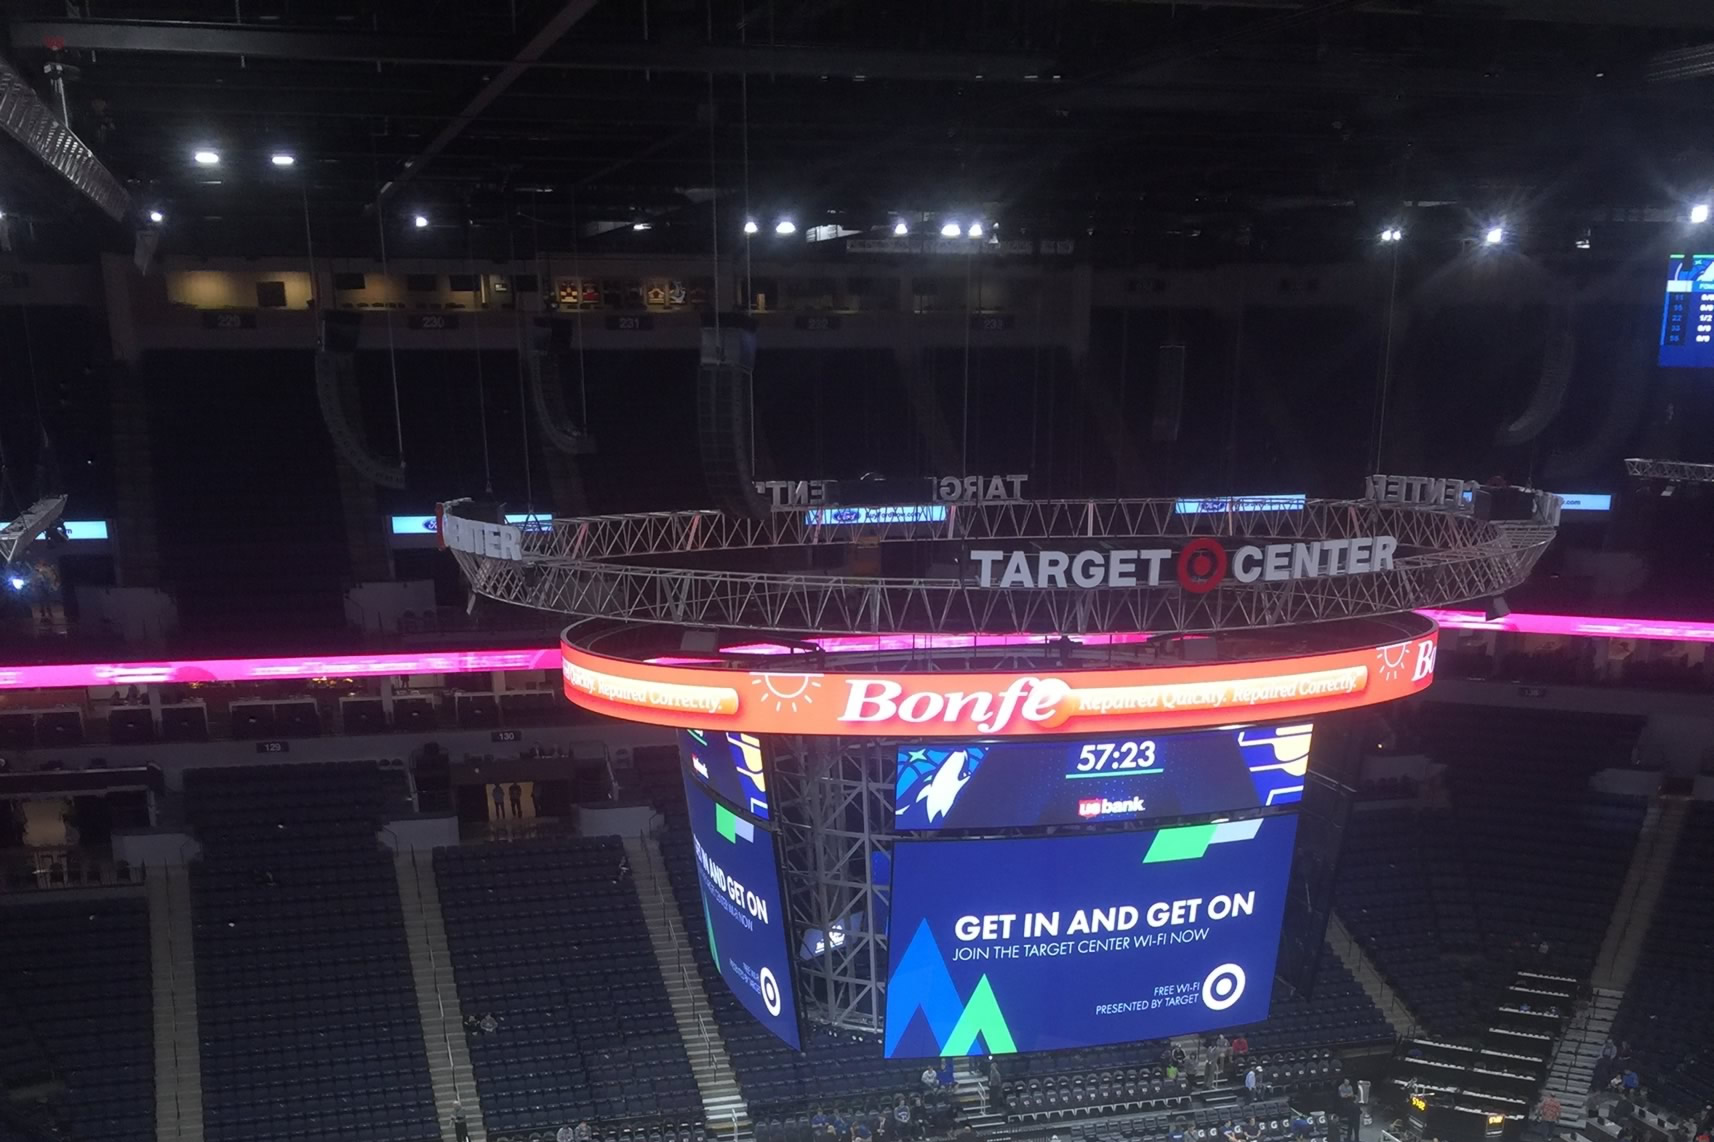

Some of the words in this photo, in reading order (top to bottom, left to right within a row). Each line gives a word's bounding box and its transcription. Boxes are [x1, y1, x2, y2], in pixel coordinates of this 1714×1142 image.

[422, 316, 445, 329] 230
[619, 317, 640, 329] 231
[970, 549, 1172, 588] TARGET
[1232, 535, 1397, 583] CENTER
[598, 680, 647, 703] Repaired
[650, 691, 722, 713] Correctly.
[837, 676, 1064, 734] Bonfe
[1079, 691, 1157, 713] Repaired
[1163, 687, 1228, 709] Quickly.
[1232, 683, 1295, 705] Repaired
[1299, 673, 1356, 695] Correctly.
[499, 732, 515, 741] 130
[264, 742, 281, 752] 129
[1077, 740, 1156, 771] 57:23
[709, 858, 727, 892] AND
[726, 875, 746, 909] GET
[747, 891, 769, 924] ON
[954, 914, 1017, 941] GET
[1023, 911, 1059, 938] IN
[1067, 906, 1139, 935] AND
[1146, 898, 1202, 927] GET
[1207, 890, 1256, 920] ON
[952, 947, 990, 961] JOIN
[994, 945, 1019, 959] THE
[1023, 941, 1074, 958] TARGET
[1077, 937, 1131, 955] CENTER
[1133, 932, 1167, 949] WI-FI
[1169, 927, 1210, 944] NOW
[1154, 983, 1175, 996] FREE
[1176, 981, 1200, 994] WI-FI
[1095, 1000, 1149, 1016] PRESENTED
[1151, 999, 1165, 1010] BY
[1165, 993, 1199, 1007] TARGET
[1210, 1128, 1217, 1136] G
[1270, 1120, 1278, 1129] G
[1283, 1119, 1290, 1128] G
